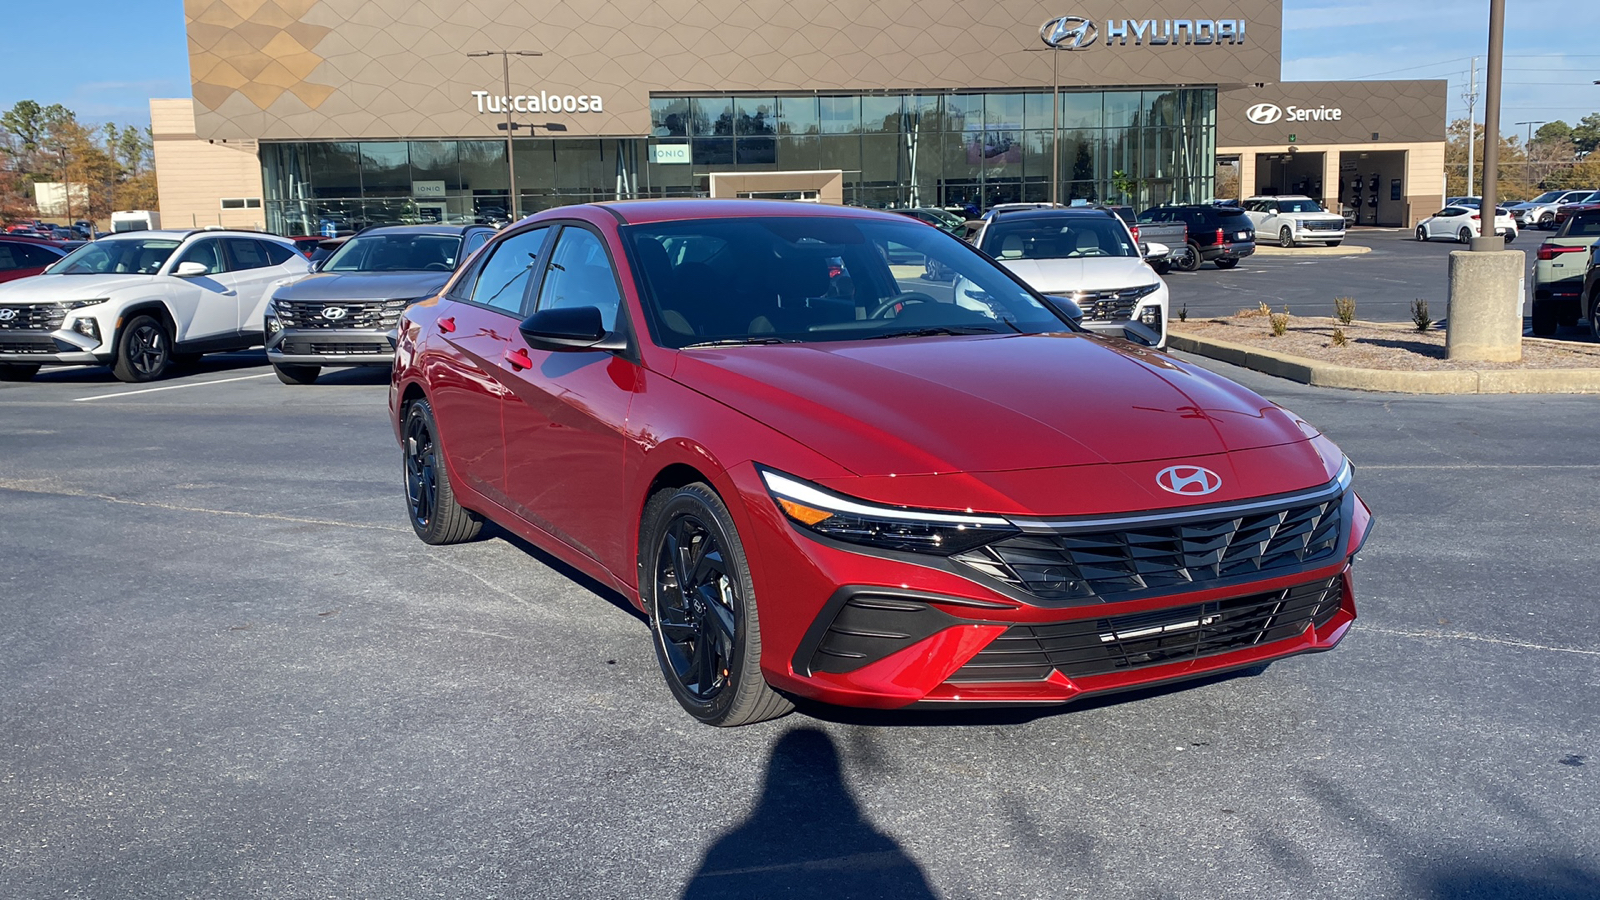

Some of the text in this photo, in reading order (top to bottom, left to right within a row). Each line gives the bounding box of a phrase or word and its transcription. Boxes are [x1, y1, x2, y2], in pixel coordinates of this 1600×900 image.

[1106, 19, 1246, 46] HYUNDAI
[471, 90, 603, 113] Tuscaloosa
[1286, 105, 1342, 122] Service
[653, 149, 685, 158] IONIQ
